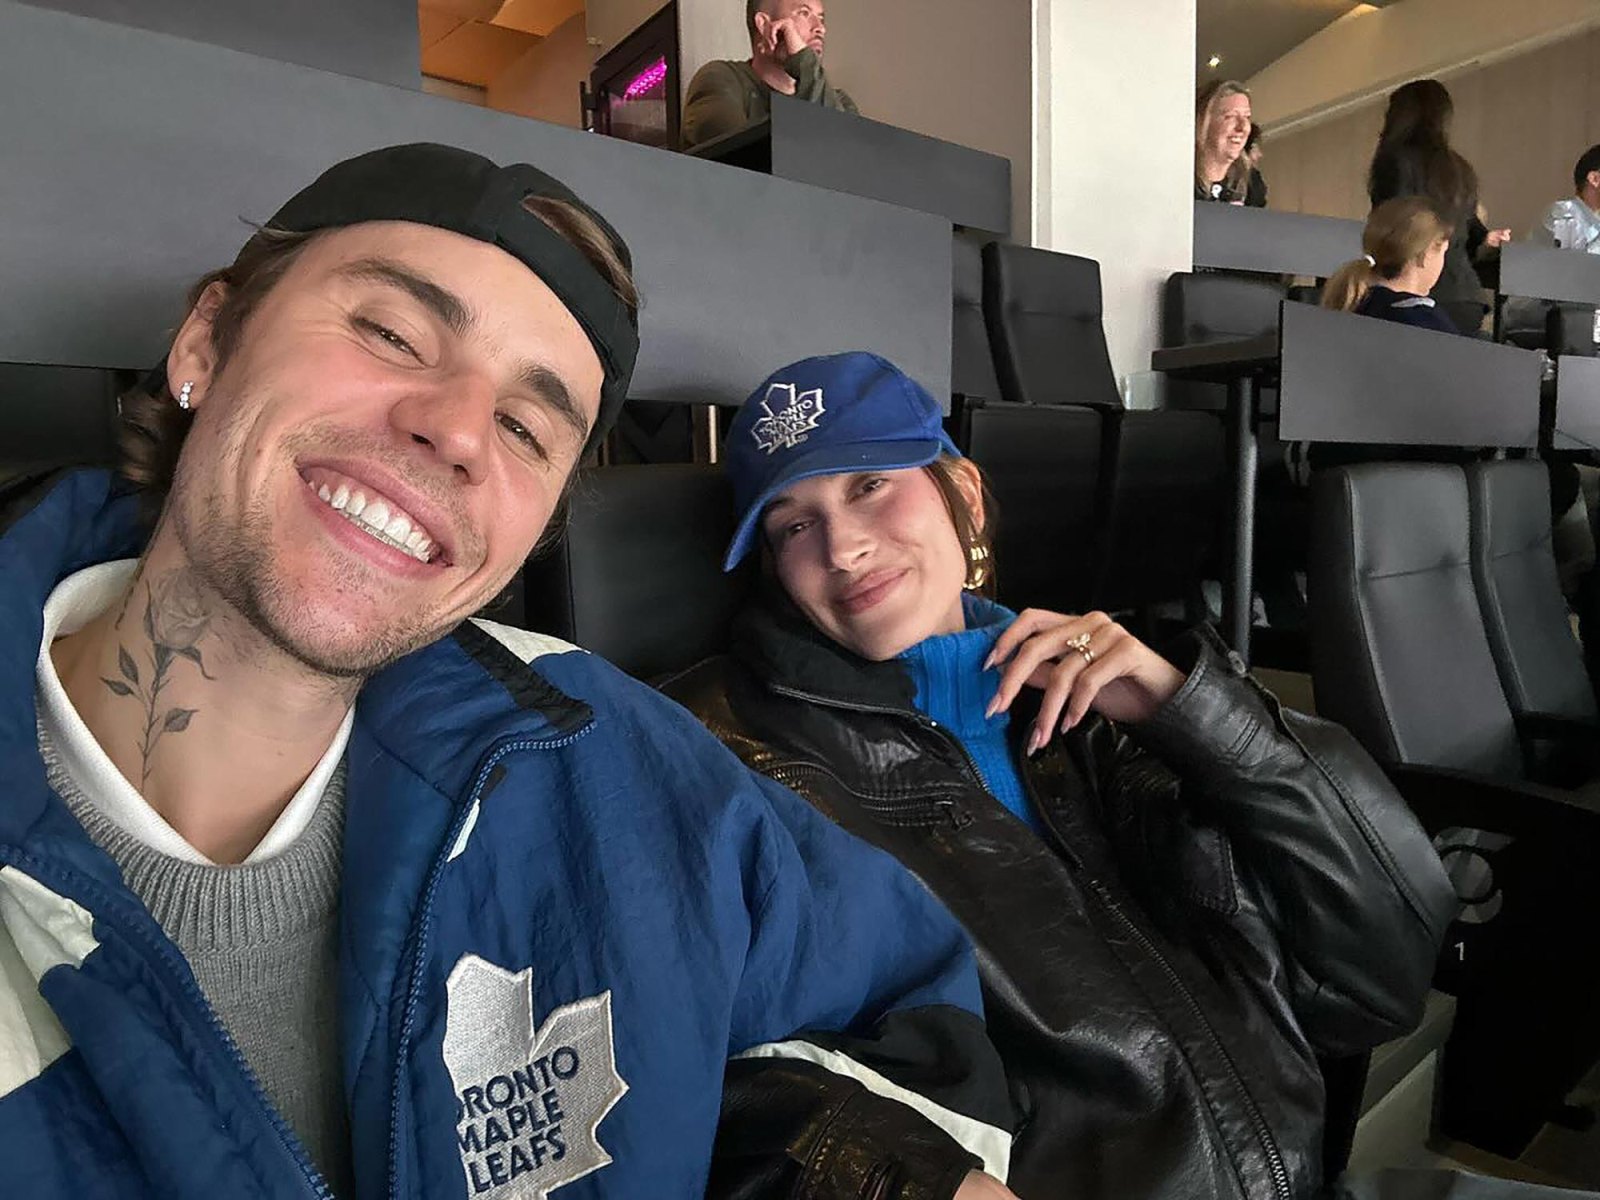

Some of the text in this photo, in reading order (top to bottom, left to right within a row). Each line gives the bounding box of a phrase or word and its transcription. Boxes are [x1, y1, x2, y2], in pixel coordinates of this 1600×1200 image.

[1454, 941, 1465, 961] 1
[458, 1046, 580, 1118] RONTO
[468, 1124, 566, 1193] LEAFS
